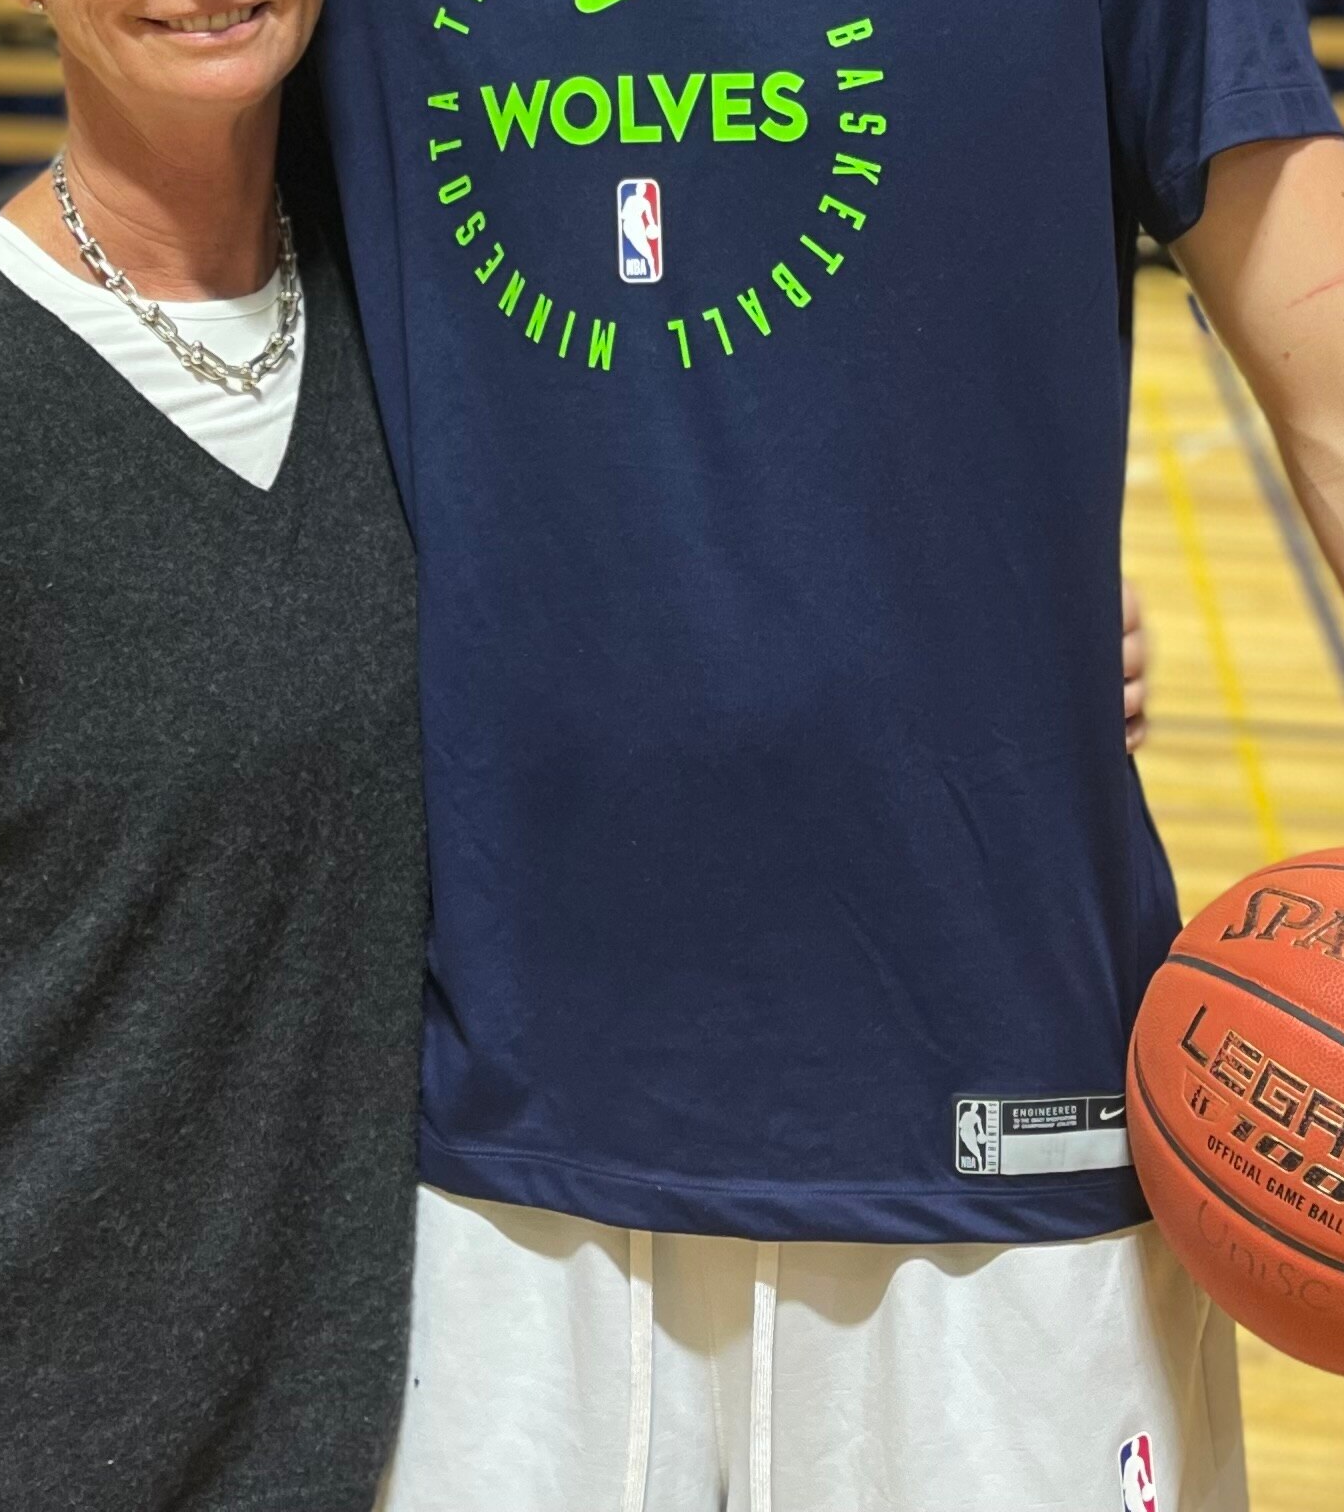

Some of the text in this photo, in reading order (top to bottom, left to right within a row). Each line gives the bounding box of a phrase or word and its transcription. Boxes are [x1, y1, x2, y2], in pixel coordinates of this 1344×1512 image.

[479, 70, 809, 153] WOLVES
[427, 90, 616, 370] MINNESOTA
[667, 18, 887, 369] BASKETBALL
[625, 257, 648, 276] NBA
[1012, 1105, 1077, 1118] ENGINEERED
[1206, 1134, 1344, 1236] OFFICIAL GAME BALL
